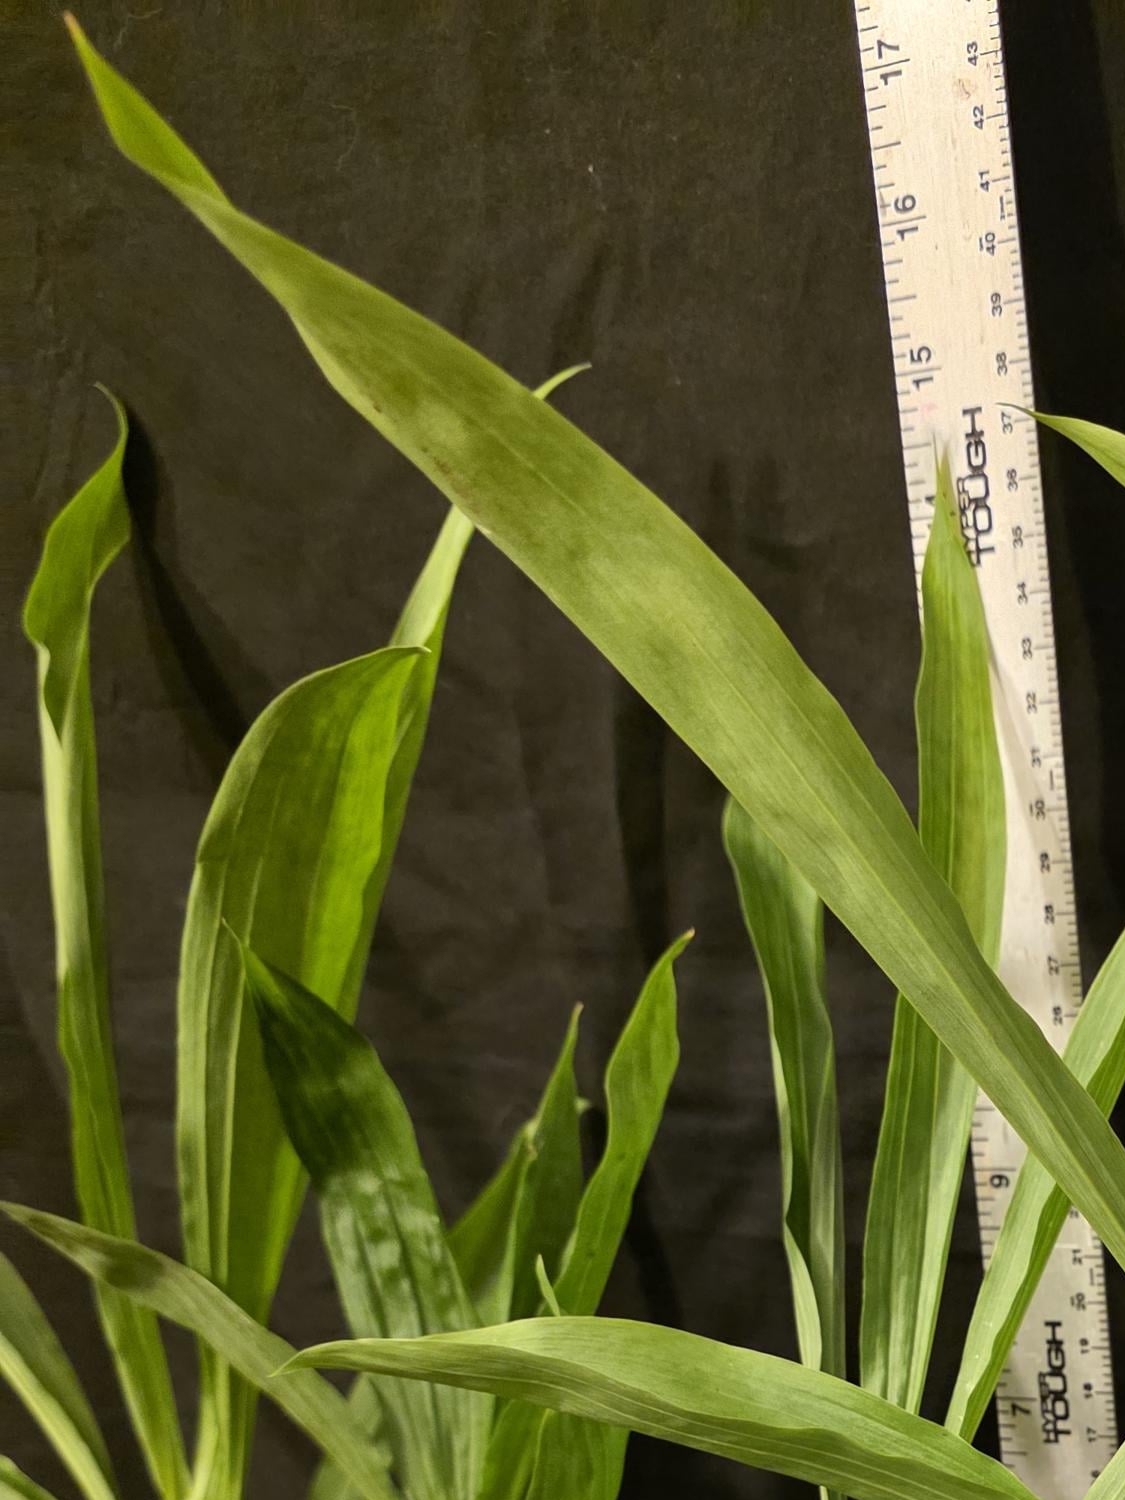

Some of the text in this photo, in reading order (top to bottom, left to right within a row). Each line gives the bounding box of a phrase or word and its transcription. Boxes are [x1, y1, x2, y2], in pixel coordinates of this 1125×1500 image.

[877, 39, 902, 86] 17
[966, 41, 979, 66] 43
[973, 104, 984, 130] 42
[979, 169, 990, 192] 41
[894, 194, 919, 241] 16
[985, 232, 997, 257] 40
[990, 292, 1003, 317] 39
[910, 345, 934, 392] 15
[996, 352, 1008, 376] 38
[1001, 411, 1014, 435] 37
[962, 406, 996, 566] TOUGH
[1006, 468, 1018, 493] 36
[1011, 525, 1024, 549] 35
[1017, 581, 1028, 605] 34
[1021, 637, 1033, 661] 33
[1026, 691, 1038, 715] 32
[1031, 746, 1042, 769] 31
[1034, 799, 1046, 821] 30
[990, 1173, 1010, 1189] 9
[1044, 1321, 1071, 1443] TOUGH
[1011, 1402, 1032, 1417] 7
[1038, 1371, 1059, 1443] HYPER
